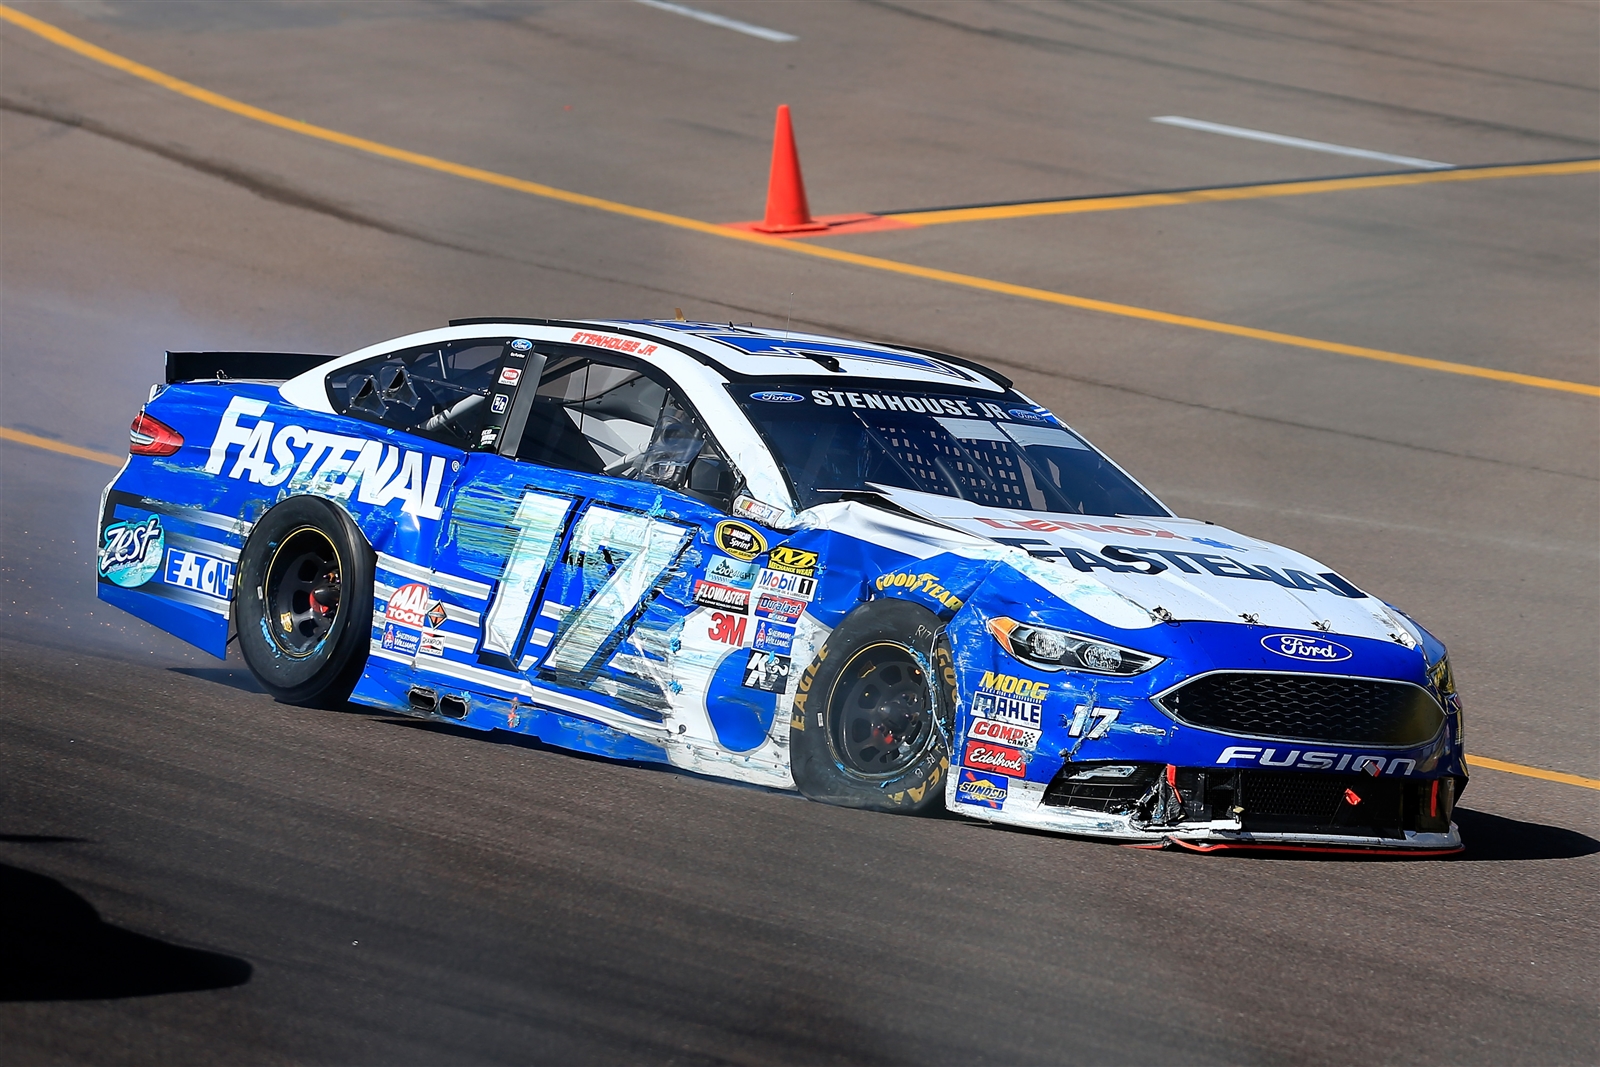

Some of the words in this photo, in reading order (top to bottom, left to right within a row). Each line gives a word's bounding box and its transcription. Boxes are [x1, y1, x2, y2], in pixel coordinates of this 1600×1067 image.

[570, 331, 642, 353] STENHOUSE
[637, 344, 659, 356] JR
[758, 391, 799, 403] Ford
[811, 389, 978, 417] STENHOUSE
[980, 402, 1012, 421] JR
[204, 395, 447, 521] FASTENAL
[750, 502, 773, 519] NASCAR
[101, 519, 161, 571] Zest
[729, 537, 751, 550] Sprint
[731, 527, 753, 542] NASCAR
[166, 549, 230, 598] EATON
[767, 559, 796, 575] MECHANIX
[795, 567, 814, 577] WEAR
[988, 537, 1369, 599] FASTENAL
[480, 487, 694, 682] 17
[759, 570, 797, 592] Mobil
[875, 572, 964, 612] GOODYEAR
[696, 583, 749, 607] FLOWMASTER
[760, 596, 803, 615] Duralast
[707, 611, 748, 648] 3M
[914, 624, 932, 639] R17
[1280, 636, 1338, 659] Ford
[790, 643, 830, 732] EAGLE
[978, 670, 1050, 701] MOOG
[973, 693, 1041, 724] MAHLE
[973, 720, 1024, 741] COMP
[1067, 703, 1121, 740] 17
[1007, 738, 1029, 748] CAMS
[969, 747, 1022, 772] Edelbrock
[1215, 746, 1418, 776] FUSION
